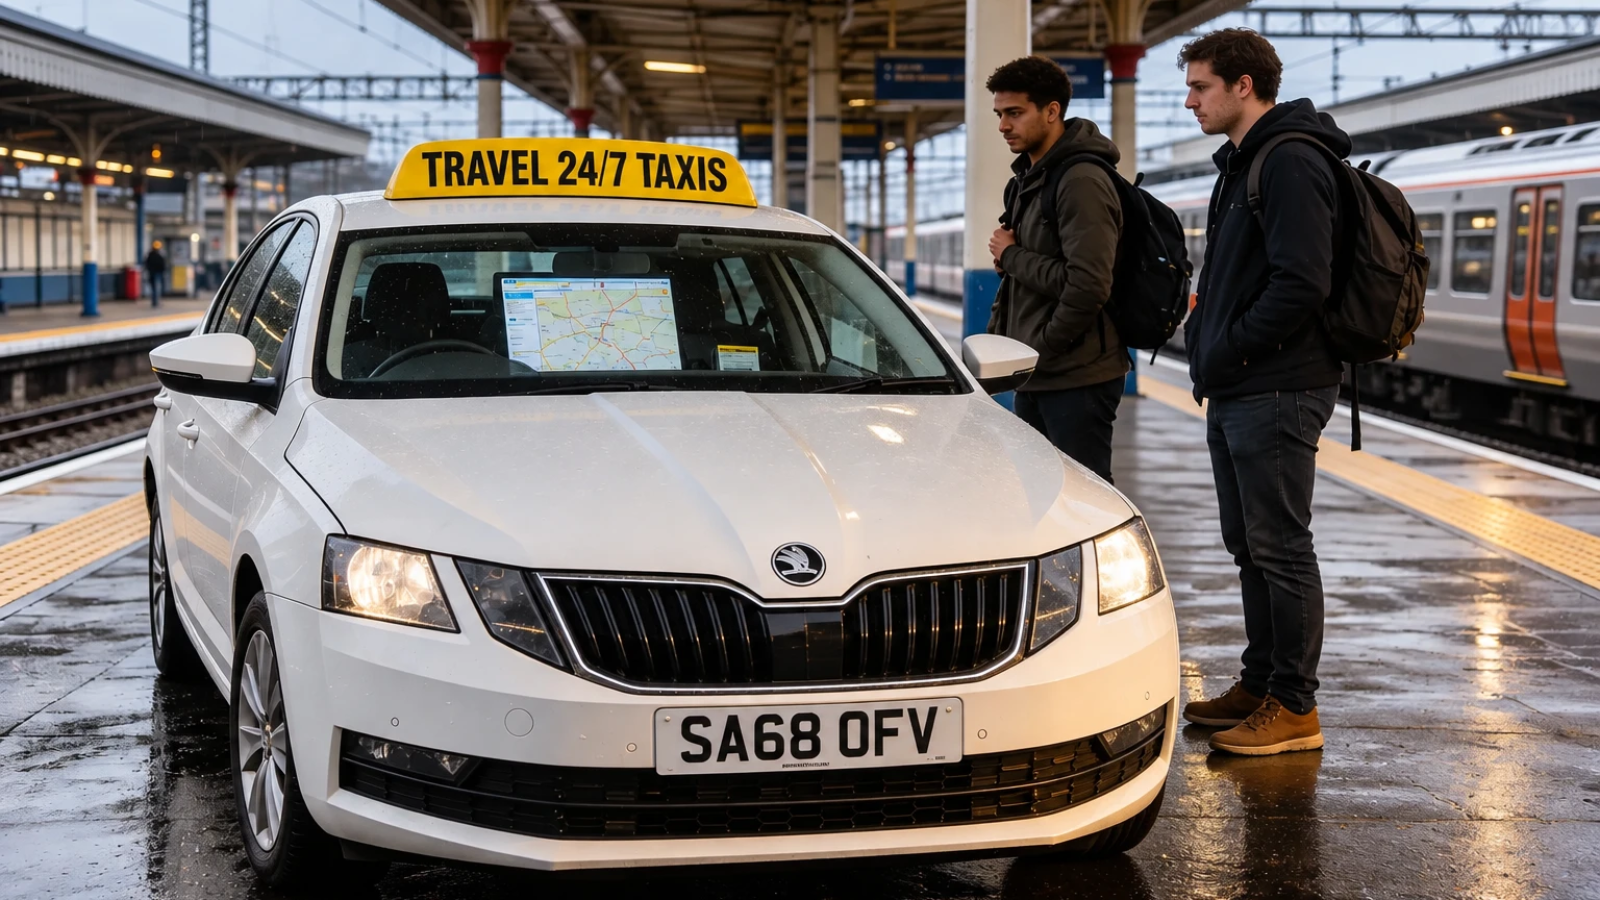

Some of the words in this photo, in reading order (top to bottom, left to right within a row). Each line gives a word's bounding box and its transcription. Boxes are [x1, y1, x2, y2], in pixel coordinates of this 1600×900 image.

[421, 150, 549, 187] TRAVEL
[557, 149, 627, 187] 24/7
[636, 152, 728, 192] TAXIS
[680, 712, 821, 763] SA68
[838, 706, 938, 758] OFV
